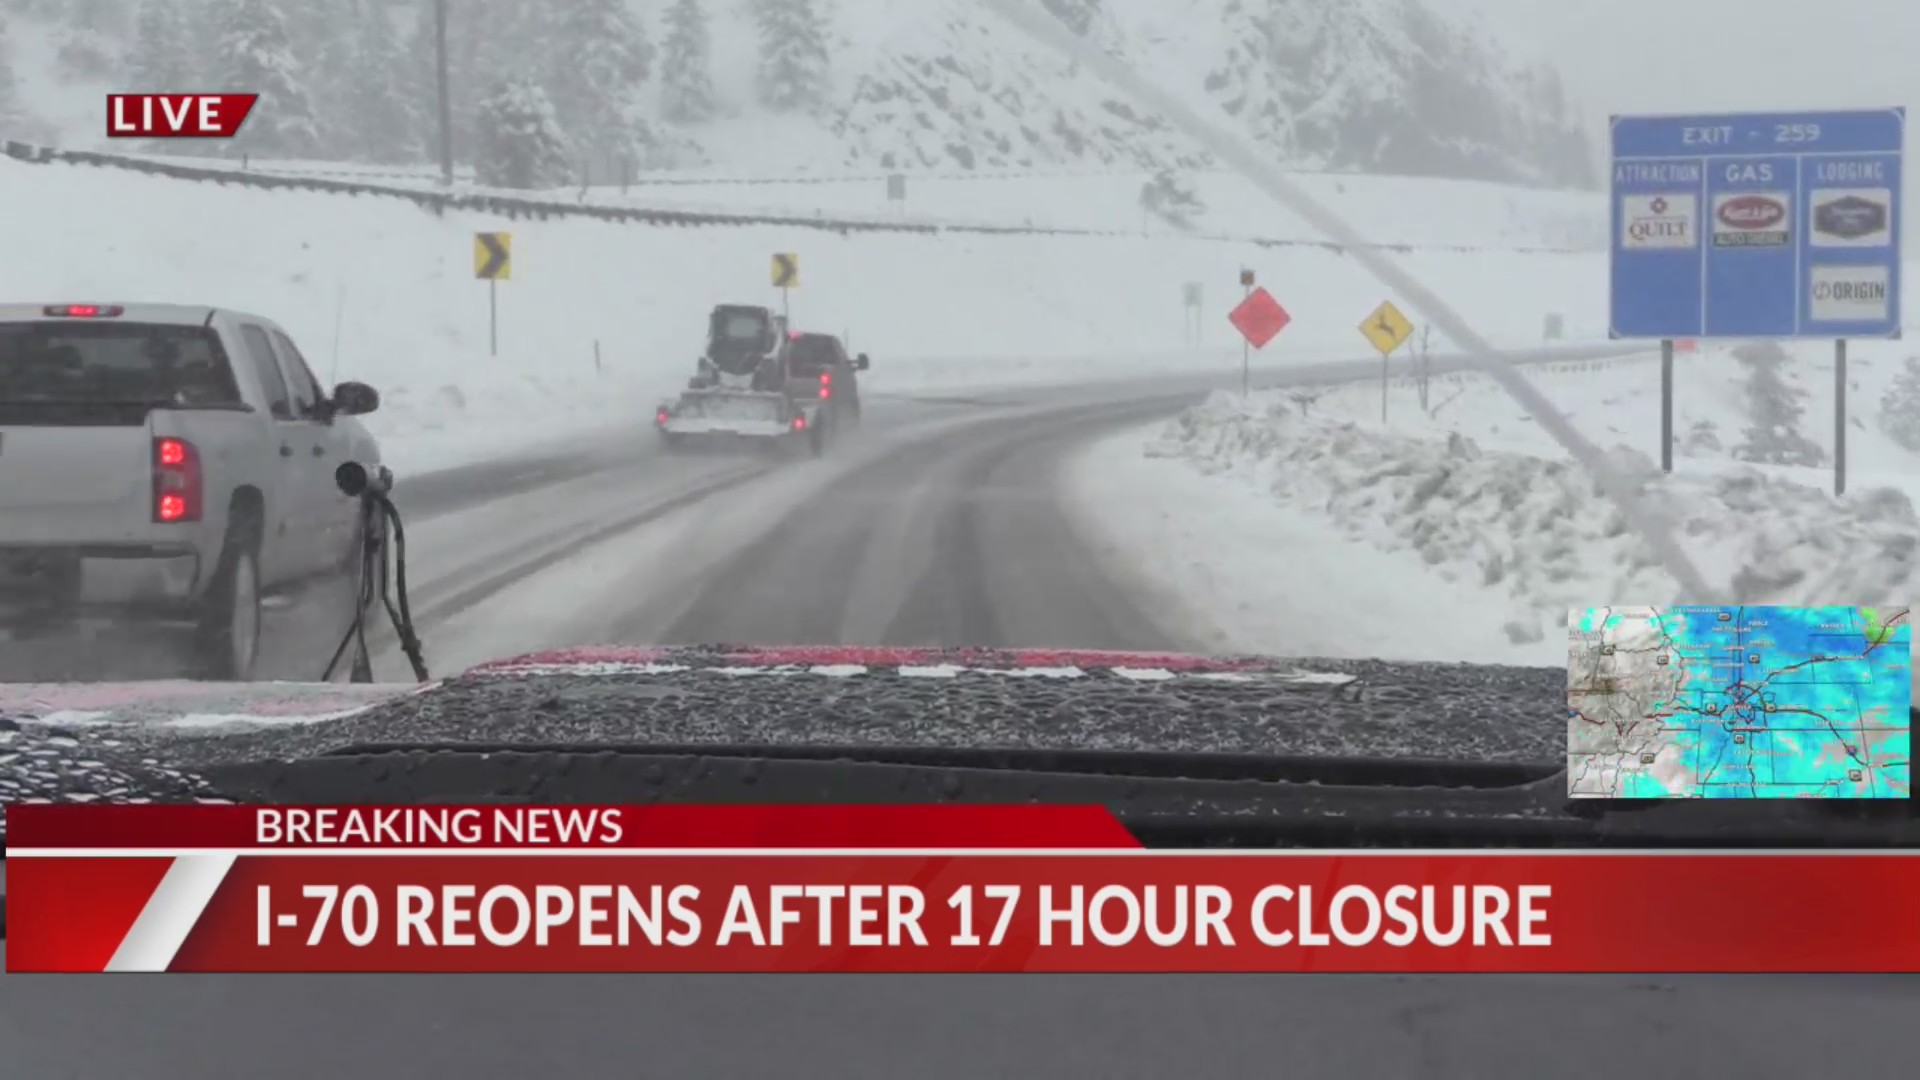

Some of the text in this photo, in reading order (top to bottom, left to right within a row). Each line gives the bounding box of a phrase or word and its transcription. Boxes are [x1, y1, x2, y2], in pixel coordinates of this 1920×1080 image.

[1682, 126, 1732, 144] EXIT
[1774, 124, 1821, 142] 259
[1615, 164, 1700, 182] ATTRACTION
[1725, 163, 1774, 182] GAS
[1817, 161, 1883, 180] LODGING
[1629, 220, 1688, 241] QUILT
[1832, 280, 1885, 301] ORIGIN
